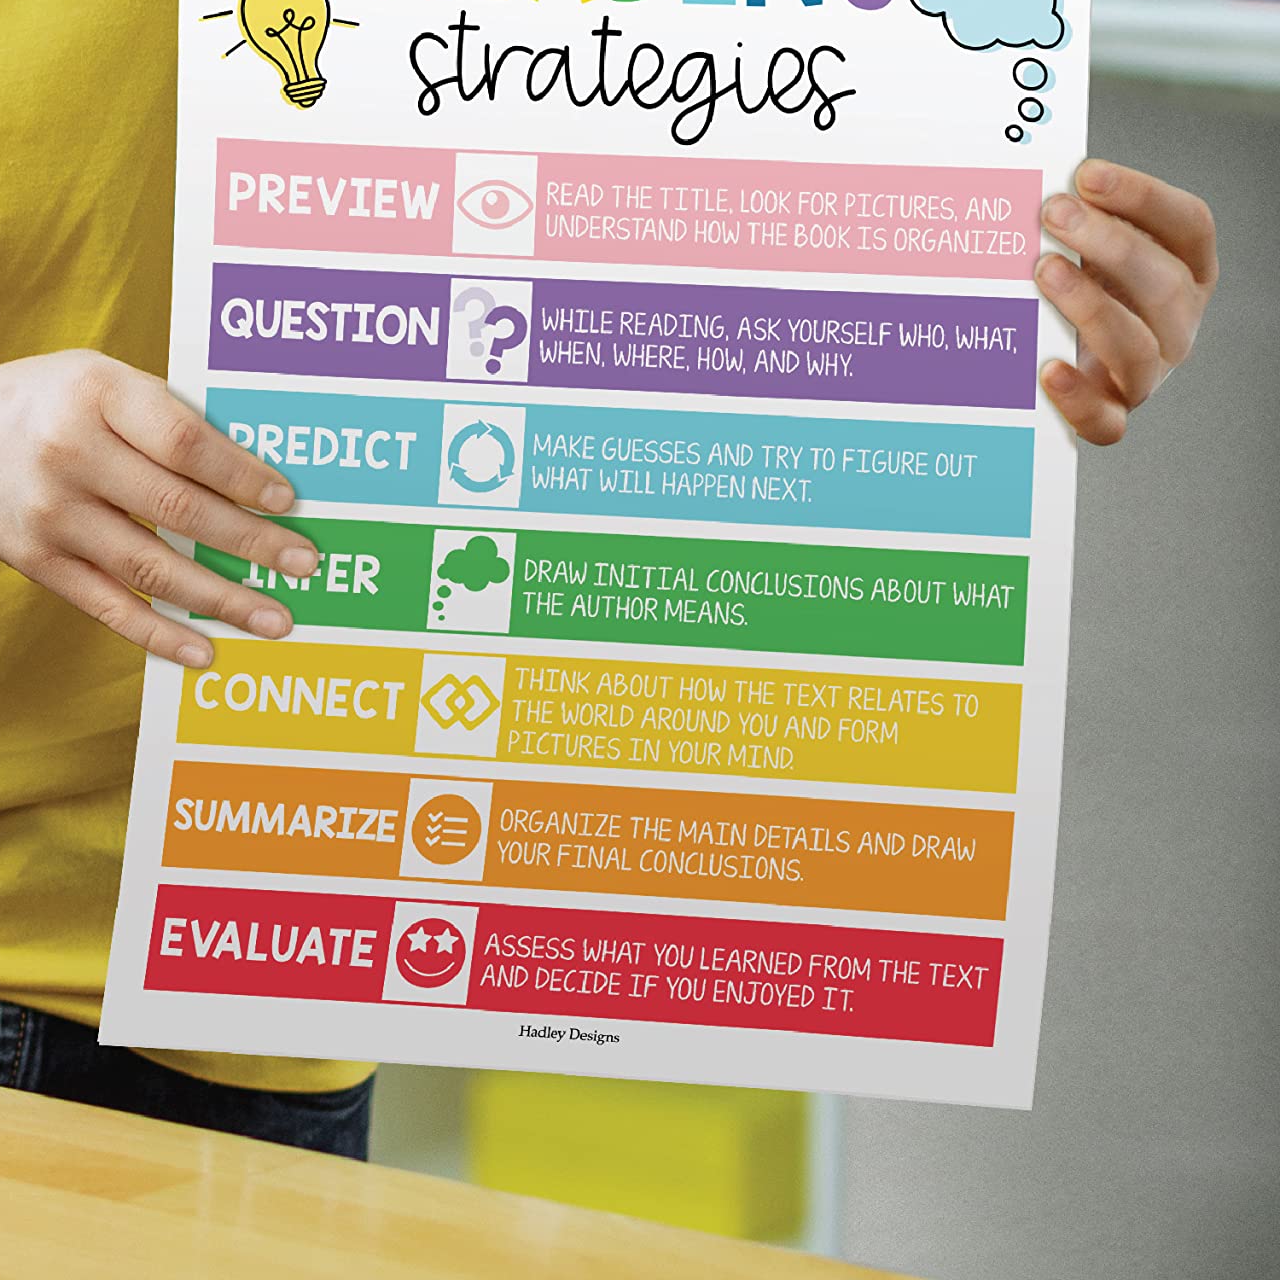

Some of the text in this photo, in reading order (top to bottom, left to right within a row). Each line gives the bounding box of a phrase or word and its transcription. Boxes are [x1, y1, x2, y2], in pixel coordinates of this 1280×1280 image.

[409, 10, 856, 144] strategies
[229, 172, 440, 220] PREVIEW
[547, 181, 1012, 222] READ THE TITLE, LOOK FOR PICTURES, AND
[546, 214, 1026, 255] UNDERSTAND HOW THE BOOK IS ORGANIZED.
[221, 298, 440, 345] QUESTION
[542, 307, 1017, 354] WHILE READING, ASK YOURSELF WHO, WHAT,
[539, 340, 853, 377] WHEN, WHERE, HOW, AND WHY.
[229, 422, 417, 470] PREDICT
[533, 433, 978, 477] MAKE GUESSES AND TRY TO FIGURE OUT
[532, 465, 812, 502] WHAT WILL HAPPEN NEXT.
[524, 559, 1015, 609] DRAW INITIAL CONCLUSIONS ABOUT WHAT
[523, 592, 748, 626] THE AUTHOR MEANS.
[195, 672, 405, 720] CONNECT
[515, 667, 979, 718] THINK ABOUT HOW THE TEXT RELATES TO
[513, 699, 898, 744] THE WORLD AROUND YOU AND FORM
[508, 730, 794, 769] PICTURES IN YOUR MIND.
[174, 798, 399, 843] SUMMARIZE
[500, 808, 976, 861] ORGANIZE THE MAIN DETAILS AND DRAW
[497, 840, 803, 881] YOUR FINAL CONCLUSIONS.
[160, 917, 377, 968] EVALUATE
[484, 933, 989, 990] ASSESS WHAT YOU LEARNED FROM THE TEXT
[480, 964, 854, 1012] AND DECIDE IF YOU ENJOYED IT.
[518, 1025, 620, 1045] Hadley Designs
